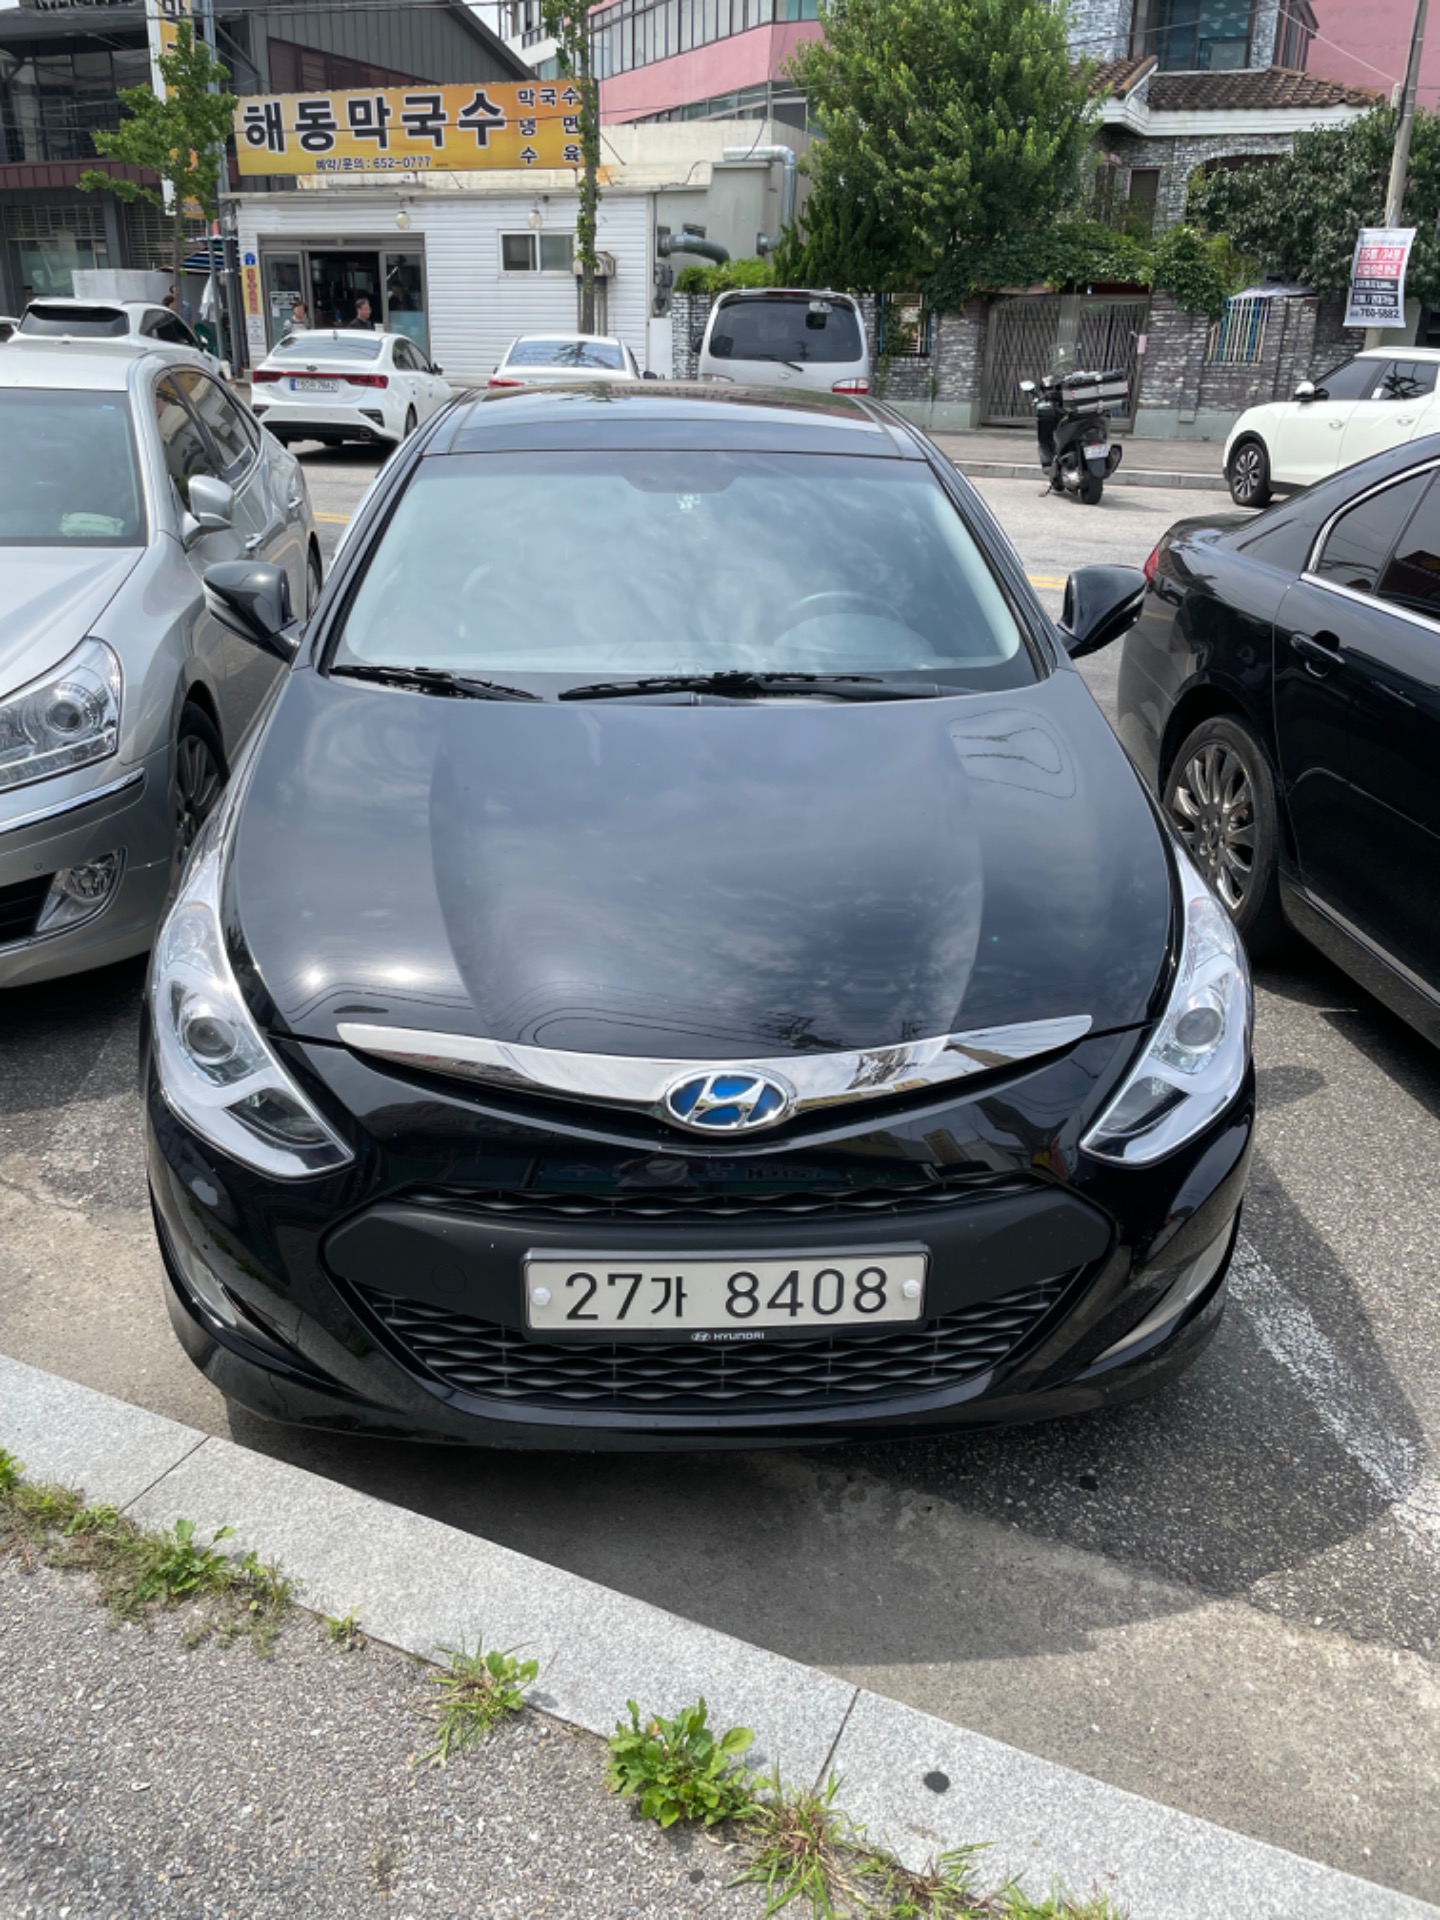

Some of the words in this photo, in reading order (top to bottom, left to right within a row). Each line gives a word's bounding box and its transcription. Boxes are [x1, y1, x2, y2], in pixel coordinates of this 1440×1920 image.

[518, 86, 579, 107] 막국수
[243, 91, 506, 153] 해동막국수
[564, 1271, 688, 1321] 27가
[724, 1266, 888, 1319] 8408
[713, 1330, 765, 1340] HYUNDAI
